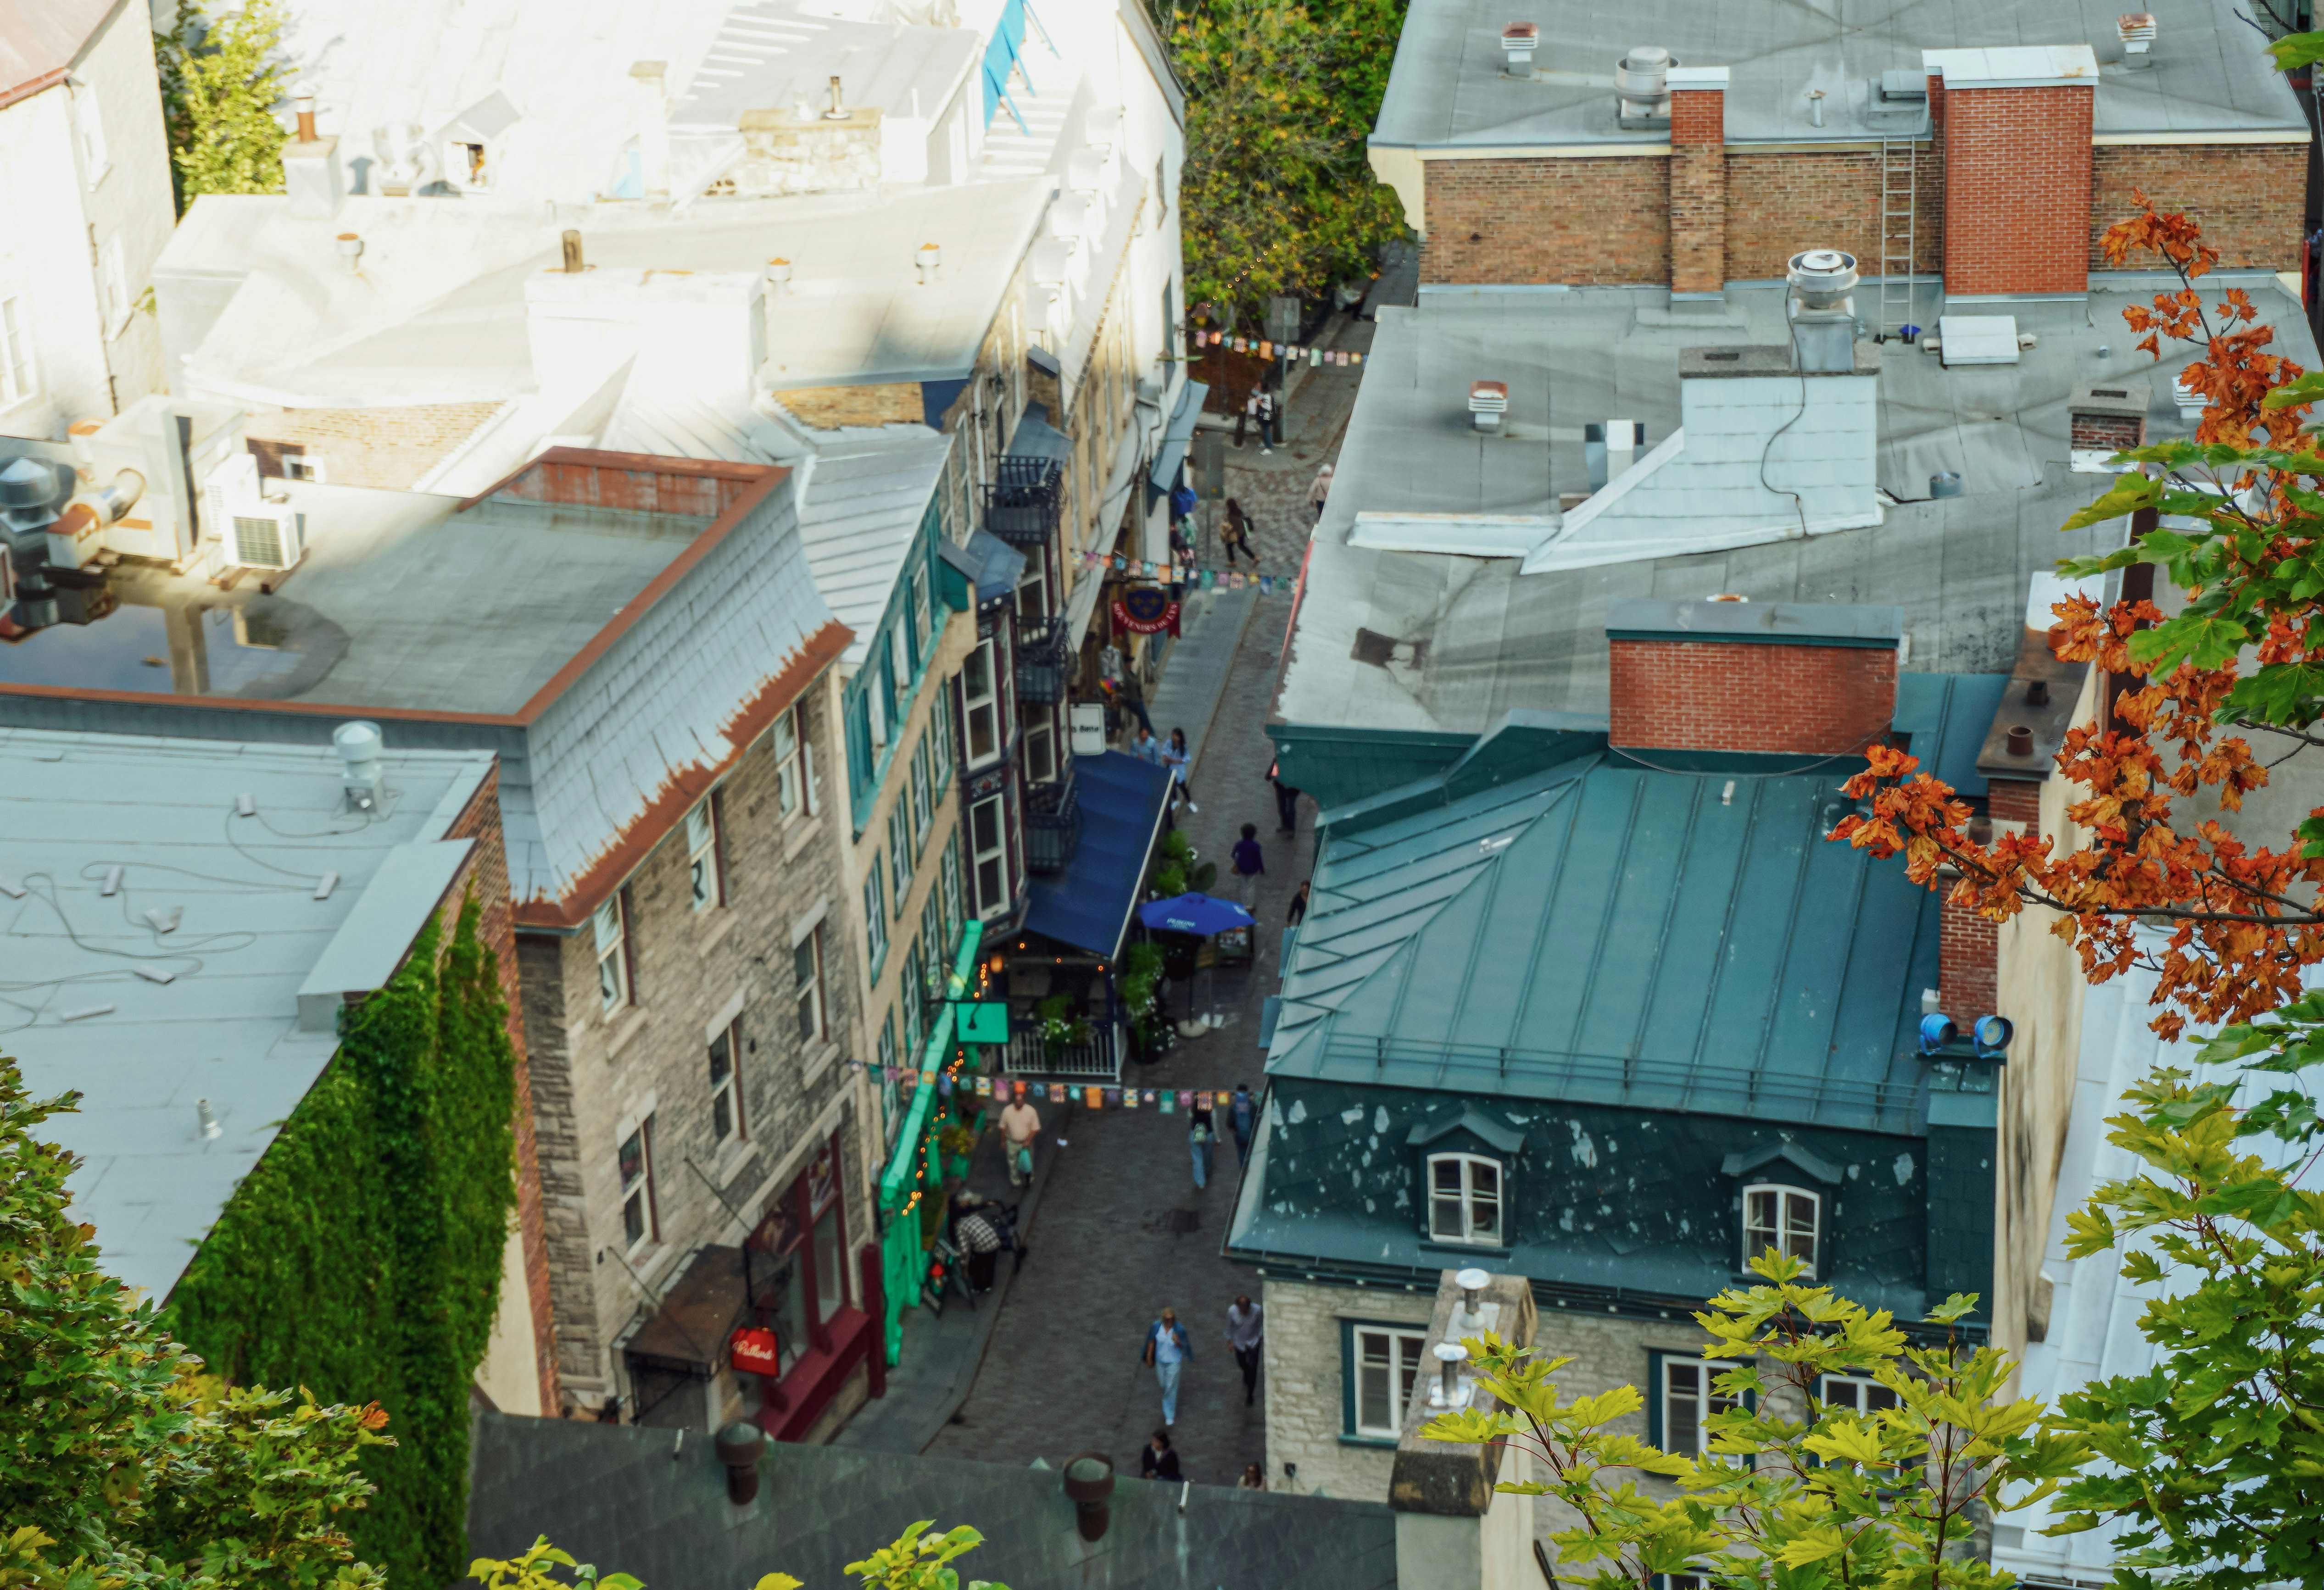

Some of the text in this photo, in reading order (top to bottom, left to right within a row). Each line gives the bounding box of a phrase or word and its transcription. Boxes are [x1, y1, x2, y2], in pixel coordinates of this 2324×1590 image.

[1114, 603, 1178, 632] SOUVENIRS DU LYS
